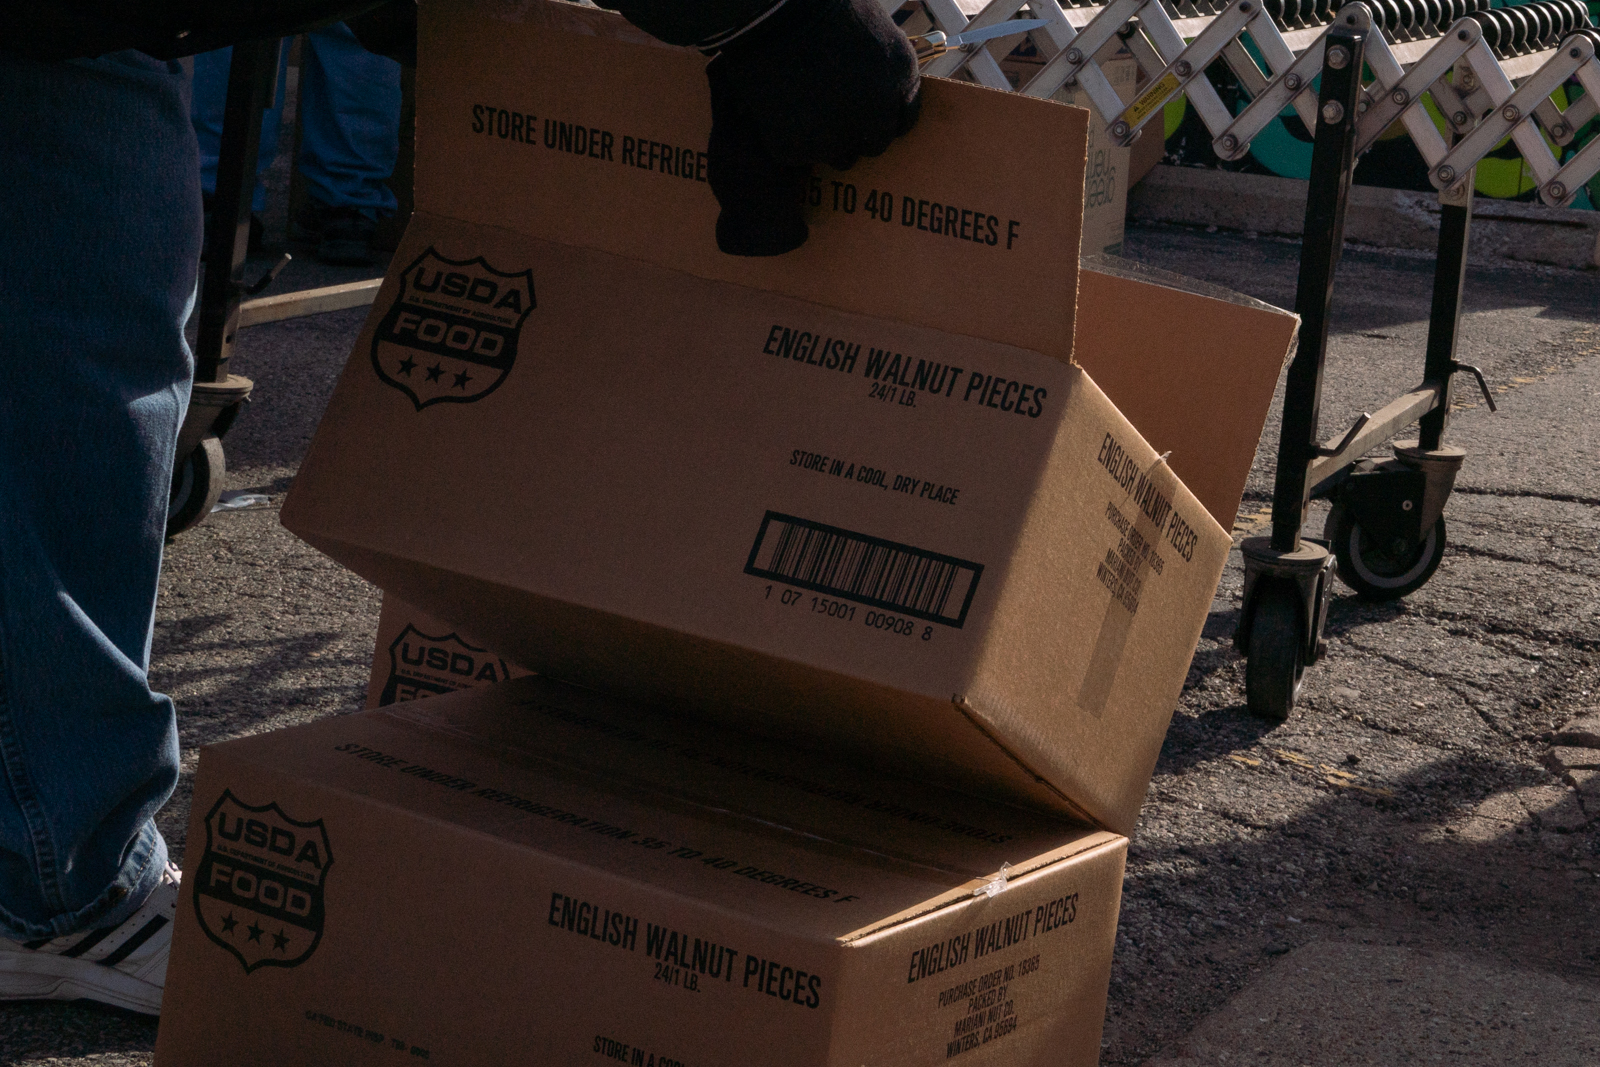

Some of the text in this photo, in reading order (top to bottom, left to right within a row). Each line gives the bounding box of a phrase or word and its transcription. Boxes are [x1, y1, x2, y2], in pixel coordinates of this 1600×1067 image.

[472, 104, 537, 145] STORE
[543, 119, 614, 162] UNDER
[622, 135, 708, 182] REFRIGE
[831, 181, 857, 214] TO
[865, 189, 894, 222] 40
[902, 196, 999, 246] DEGREES
[1006, 219, 1020, 250] F
[413, 267, 522, 315] USDA
[392, 312, 505, 357] FOOD
[762, 325, 1048, 418] ENGLISH WALNUT PIECES
[868, 382, 917, 408] 24/1 LB.
[790, 449, 960, 505] STORE IN A COOL, DRY PLACE
[1097, 432, 1198, 563] ENGLISH WALNUT PIECES
[1105, 501, 1131, 538] PURCHASE
[1117, 538, 1146, 573] PACKED BY
[764, 585, 933, 641] 1 07 15001 00908 8
[401, 642, 498, 683] USDA
[218, 812, 322, 869] USDA
[334, 743, 860, 903] STORE UNDER REFRIGERATION 35 TO 40 DEGREES F
[209, 862, 312, 918] FOOD
[548, 892, 822, 1009] ENGLISH WALNUT PIECES
[907, 892, 1079, 984] ENGLISH WALNUT PIECES
[654, 962, 701, 993] 24/1 LB.
[938, 954, 1041, 1009] PURCHASE ORDER NO. 18365
[967, 984, 1009, 1014] PACKED BY
[946, 1015, 1018, 1059] WINTERS, CA 95694
[954, 999, 1014, 1038] MARIANI NUT CO.
[593, 1035, 629, 1063] STORE
[631, 1047, 645, 1067] IN
